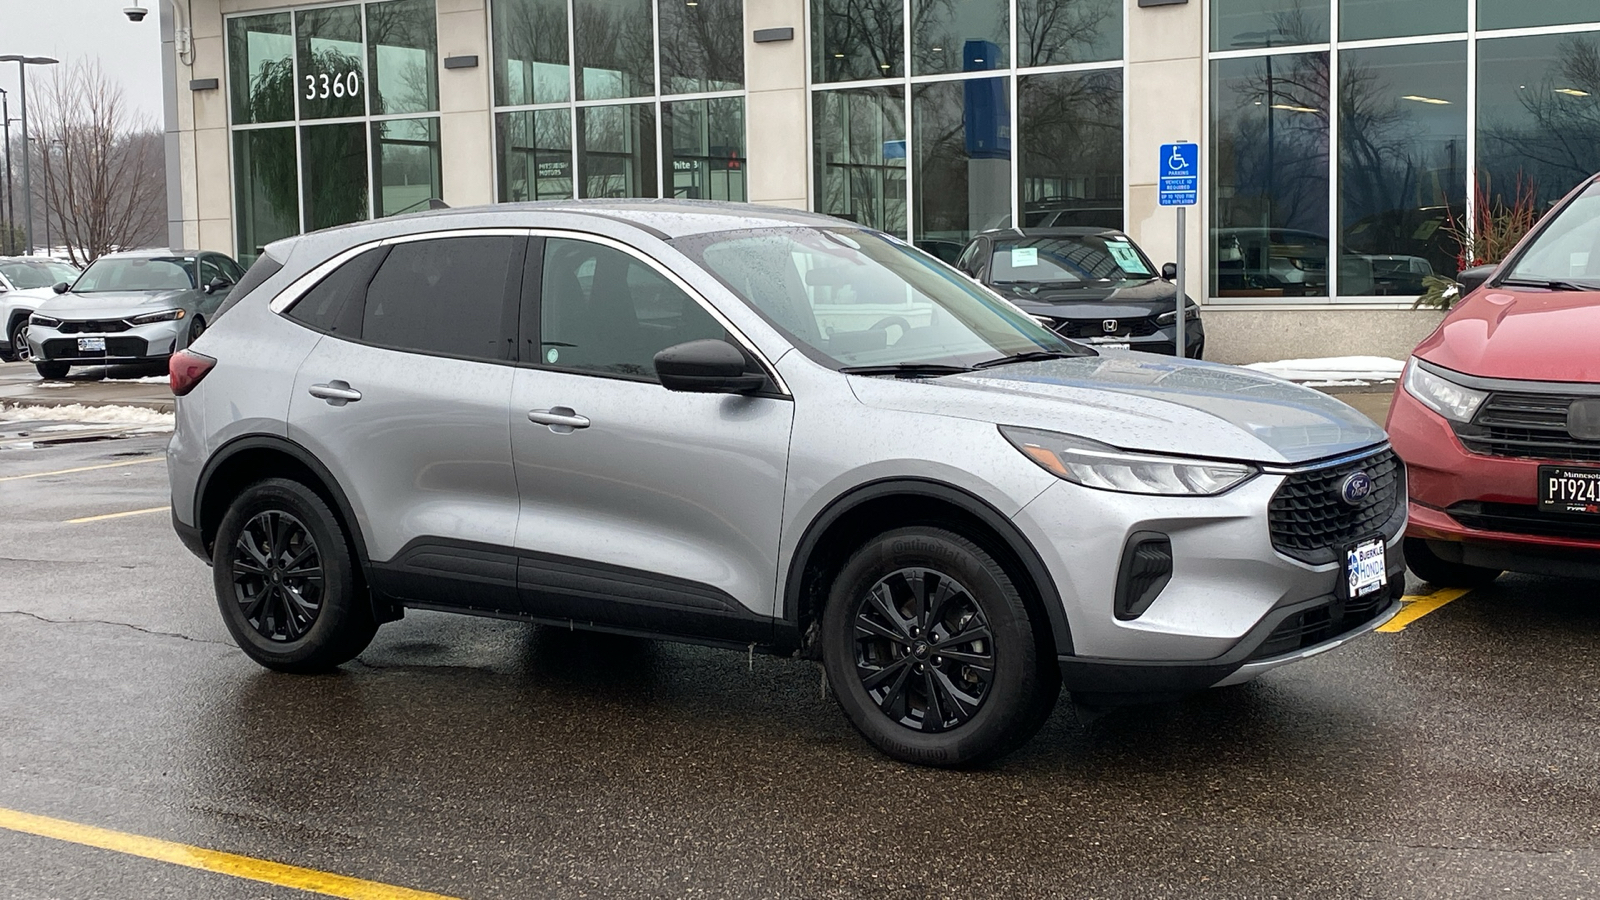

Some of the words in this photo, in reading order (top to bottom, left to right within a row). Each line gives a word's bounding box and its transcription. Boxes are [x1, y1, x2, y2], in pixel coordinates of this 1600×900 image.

[306, 71, 359, 100] 3360
[673, 160, 691, 170] hite
[1563, 471, 1600, 479] Minnesot
[892, 537, 960, 561] Continental
[1359, 545, 1383, 562] BUERKLE
[1360, 560, 1384, 580] HONDA
